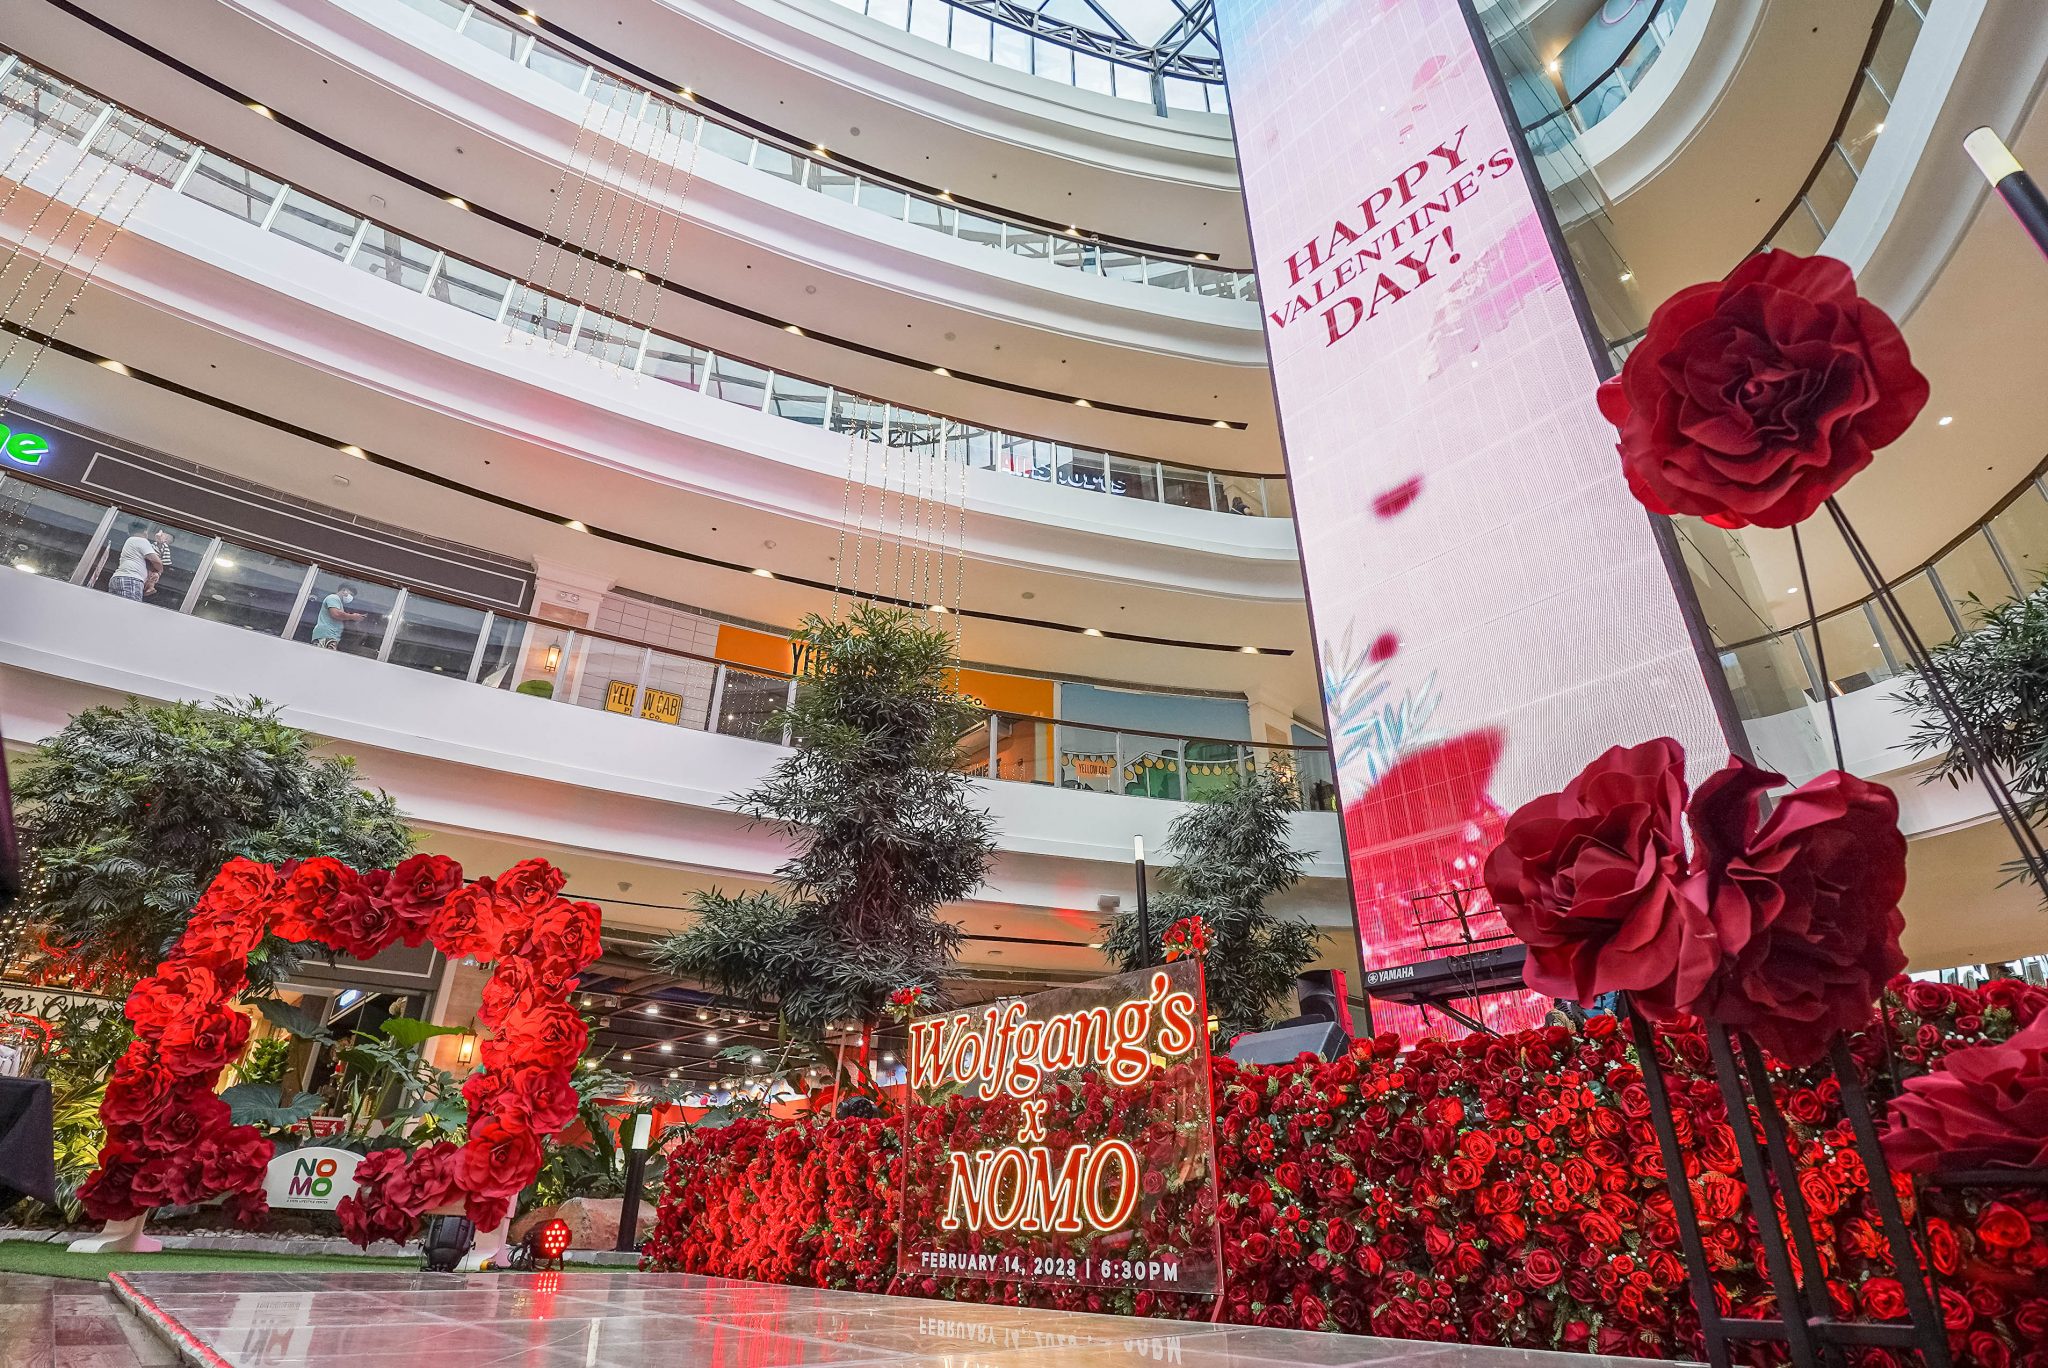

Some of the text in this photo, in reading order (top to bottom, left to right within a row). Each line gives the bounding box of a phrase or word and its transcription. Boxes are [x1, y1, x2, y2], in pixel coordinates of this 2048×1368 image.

[1284, 125, 1468, 288] HAPPY
[1269, 148, 1514, 329] VALENTINE'S
[1320, 225, 1461, 348] DAY!
[613, 684, 678, 717] YELLW CAB
[623, 706, 646, 717] Pia
[1078, 763, 1098, 775] YELLOW
[1378, 966, 1415, 982] YAMAHA
[909, 971, 1199, 1101] Wolfgang's
[1018, 1099, 1049, 1143] x
[941, 1139, 1141, 1233] NOMO
[921, 1252, 998, 1272] FEBRUARY
[1004, 1256, 1026, 1276] 14,
[1034, 1257, 1077, 1277] 2023
[1101, 1260, 1179, 1282] 6:30PM
